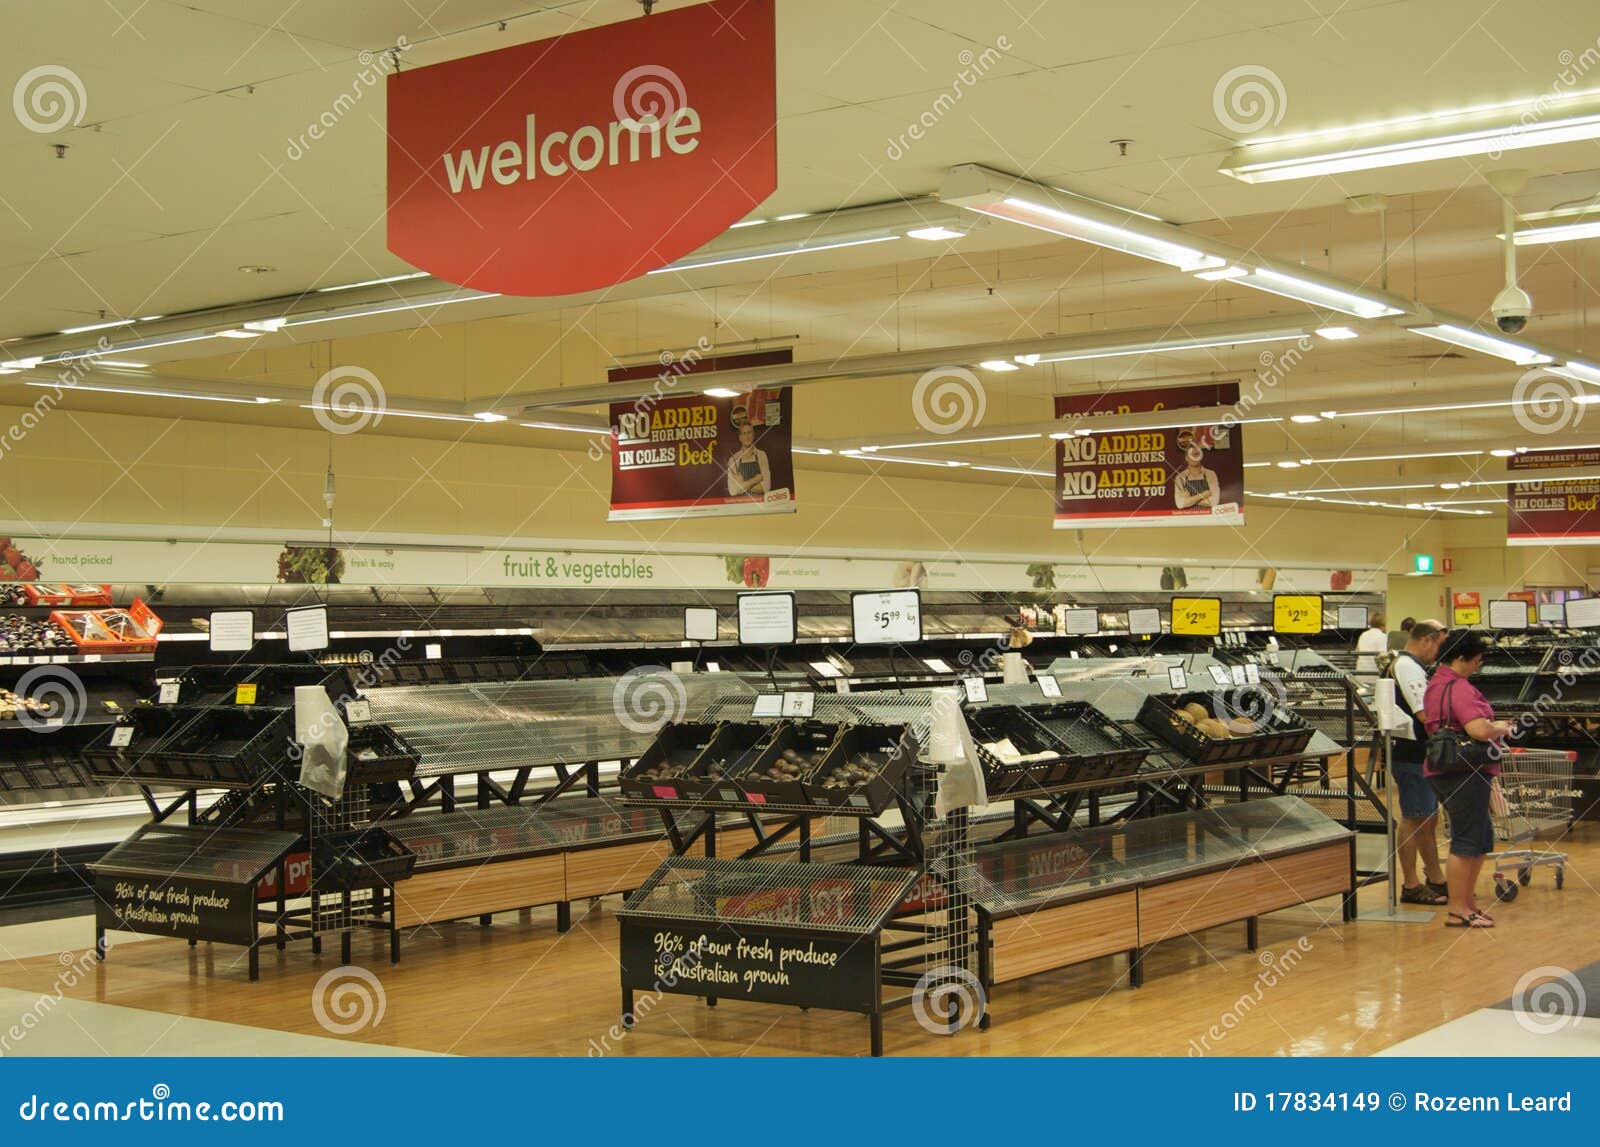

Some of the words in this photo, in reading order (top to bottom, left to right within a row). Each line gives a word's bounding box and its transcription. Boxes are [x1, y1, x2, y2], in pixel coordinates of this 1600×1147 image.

[443, 106, 702, 194] welcome
[618, 412, 650, 440] NO
[651, 405, 718, 429] ADDED
[651, 425, 717, 443] HORMONES
[619, 450, 634, 465] IN
[636, 448, 676, 464] COLES
[679, 440, 718, 466] Beef
[1063, 437, 1096, 461] NO
[1099, 433, 1165, 453] ADDED
[1097, 451, 1165, 465] HORMONES
[1063, 471, 1096, 495] NO
[1098, 467, 1166, 488] ADDED
[1097, 486, 1125, 498] COST
[1128, 486, 1141, 497] TO
[1144, 485, 1166, 497] YOU
[1514, 499, 1528, 509] IN
[1529, 498, 1566, 509] COLES
[1568, 493, 1599, 512] Beef
[52, 554, 77, 565] hand
[80, 554, 113, 567] picked
[503, 555, 541, 577] fruit
[545, 556, 559, 578] &
[562, 558, 653, 584] vegetables
[115, 882, 135, 900] 96%
[138, 884, 148, 900] of
[149, 889, 164, 902] our
[167, 887, 190, 906] fresh
[193, 889, 230, 912] produce
[115, 904, 123, 918] is
[125, 903, 168, 923] Australian
[170, 911, 200, 930] grown
[653, 931, 684, 953] 96%
[690, 934, 706, 954] of
[708, 941, 732, 957] our
[737, 937, 773, 962] fresh
[779, 941, 838, 967] produce
[653, 958, 665, 976] is
[669, 957, 739, 984] Australian
[743, 969, 790, 993] grown
